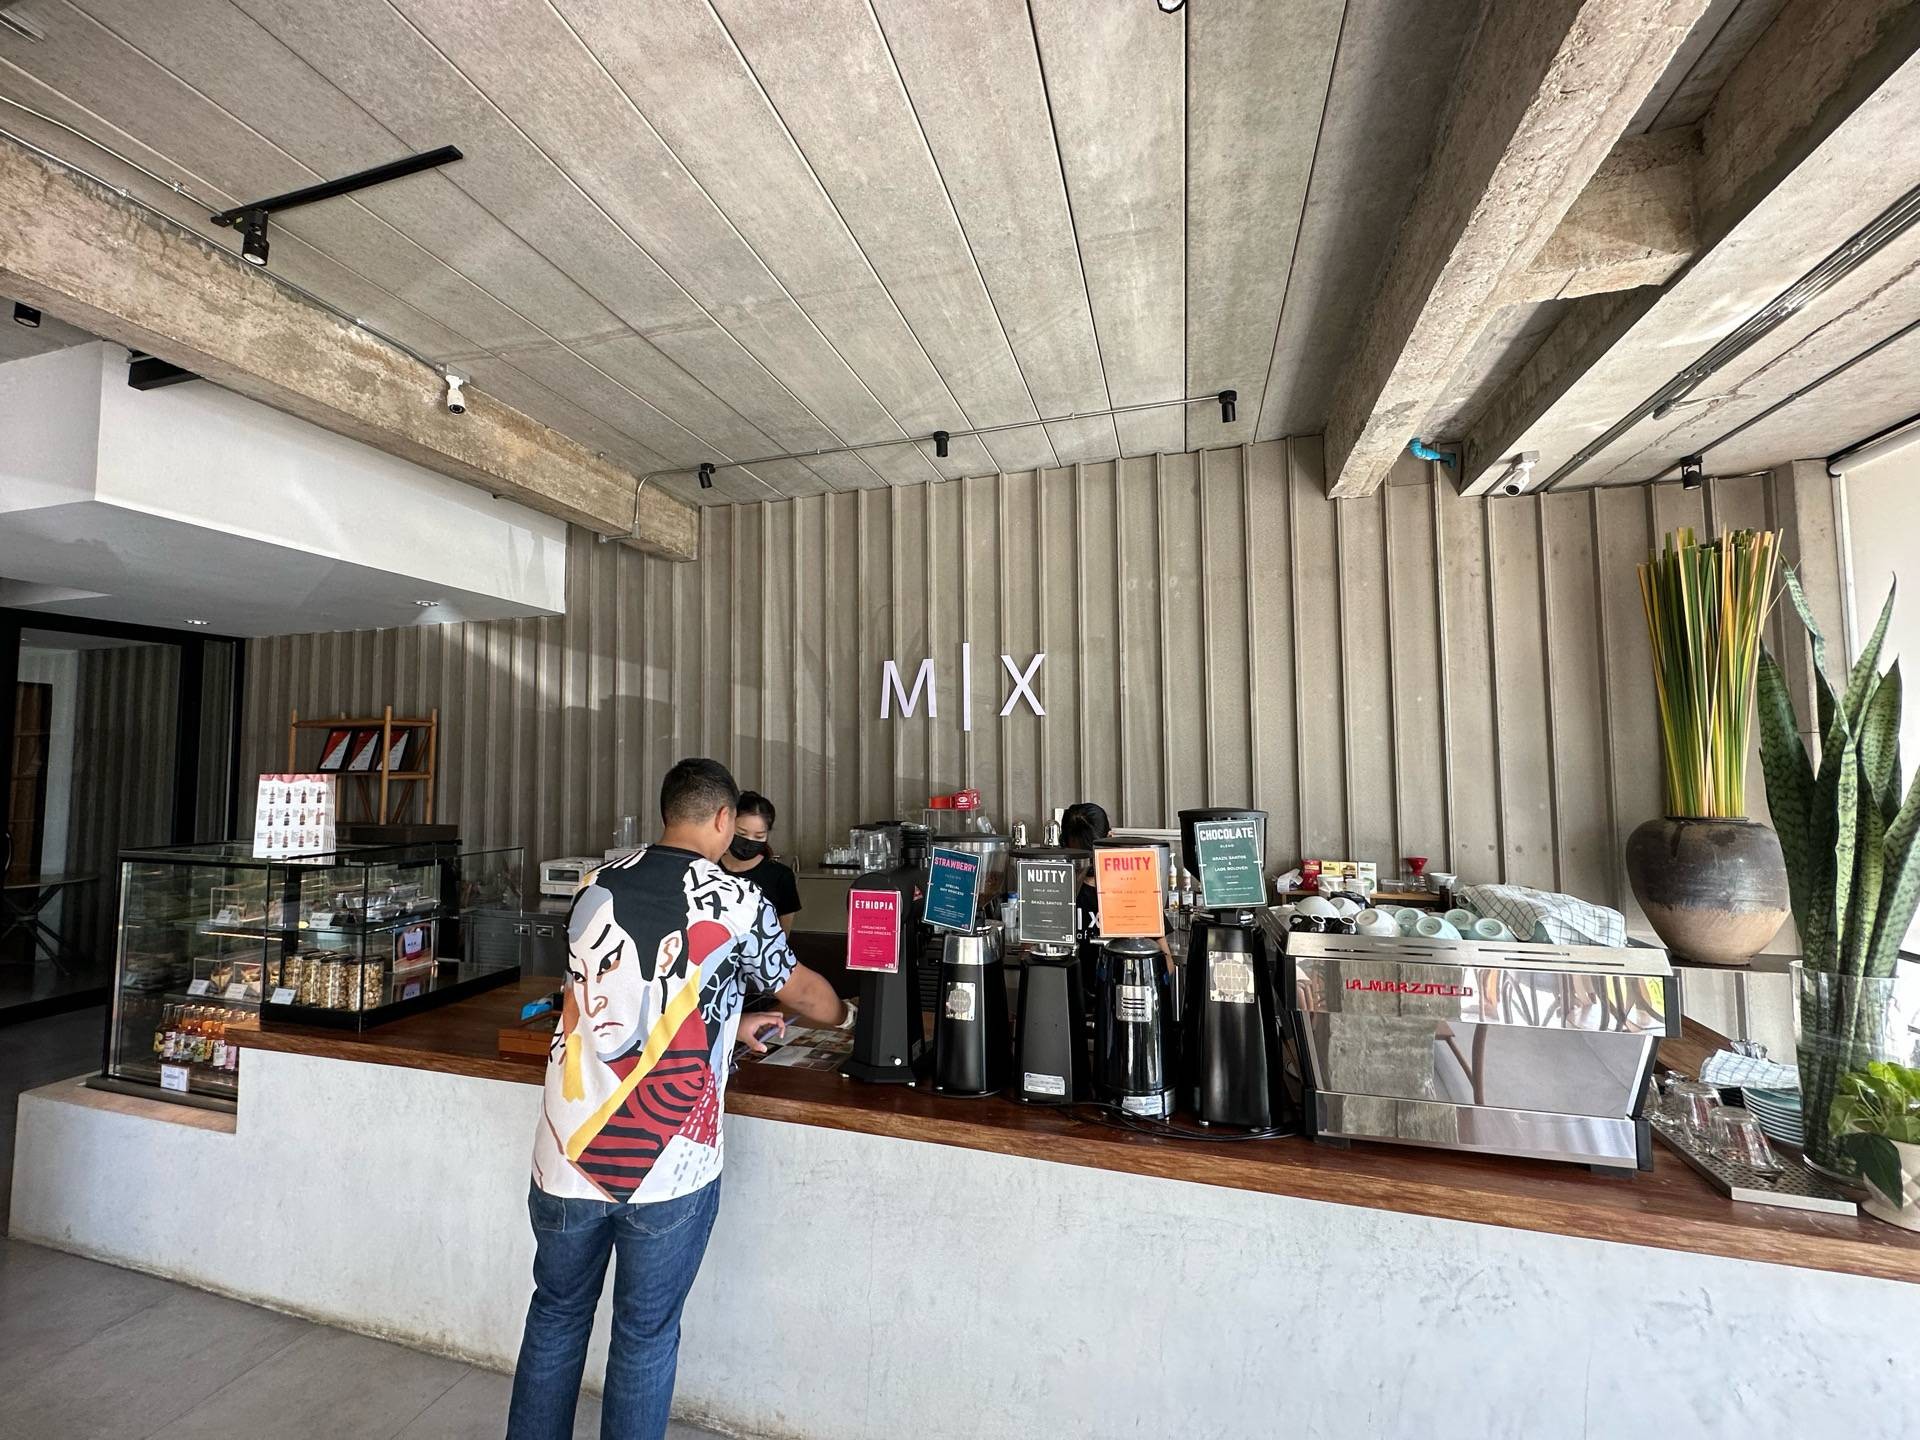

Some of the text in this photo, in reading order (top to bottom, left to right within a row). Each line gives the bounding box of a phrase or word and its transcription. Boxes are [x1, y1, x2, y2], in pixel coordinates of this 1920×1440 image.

[1199, 827, 1254, 841] CHOCOLATE
[934, 857, 977, 873] STRAWBERRY
[1104, 857, 1151, 872] FRUITY
[1027, 869, 1066, 883] NUTTY
[855, 900, 894, 911] ETHIOPIA
